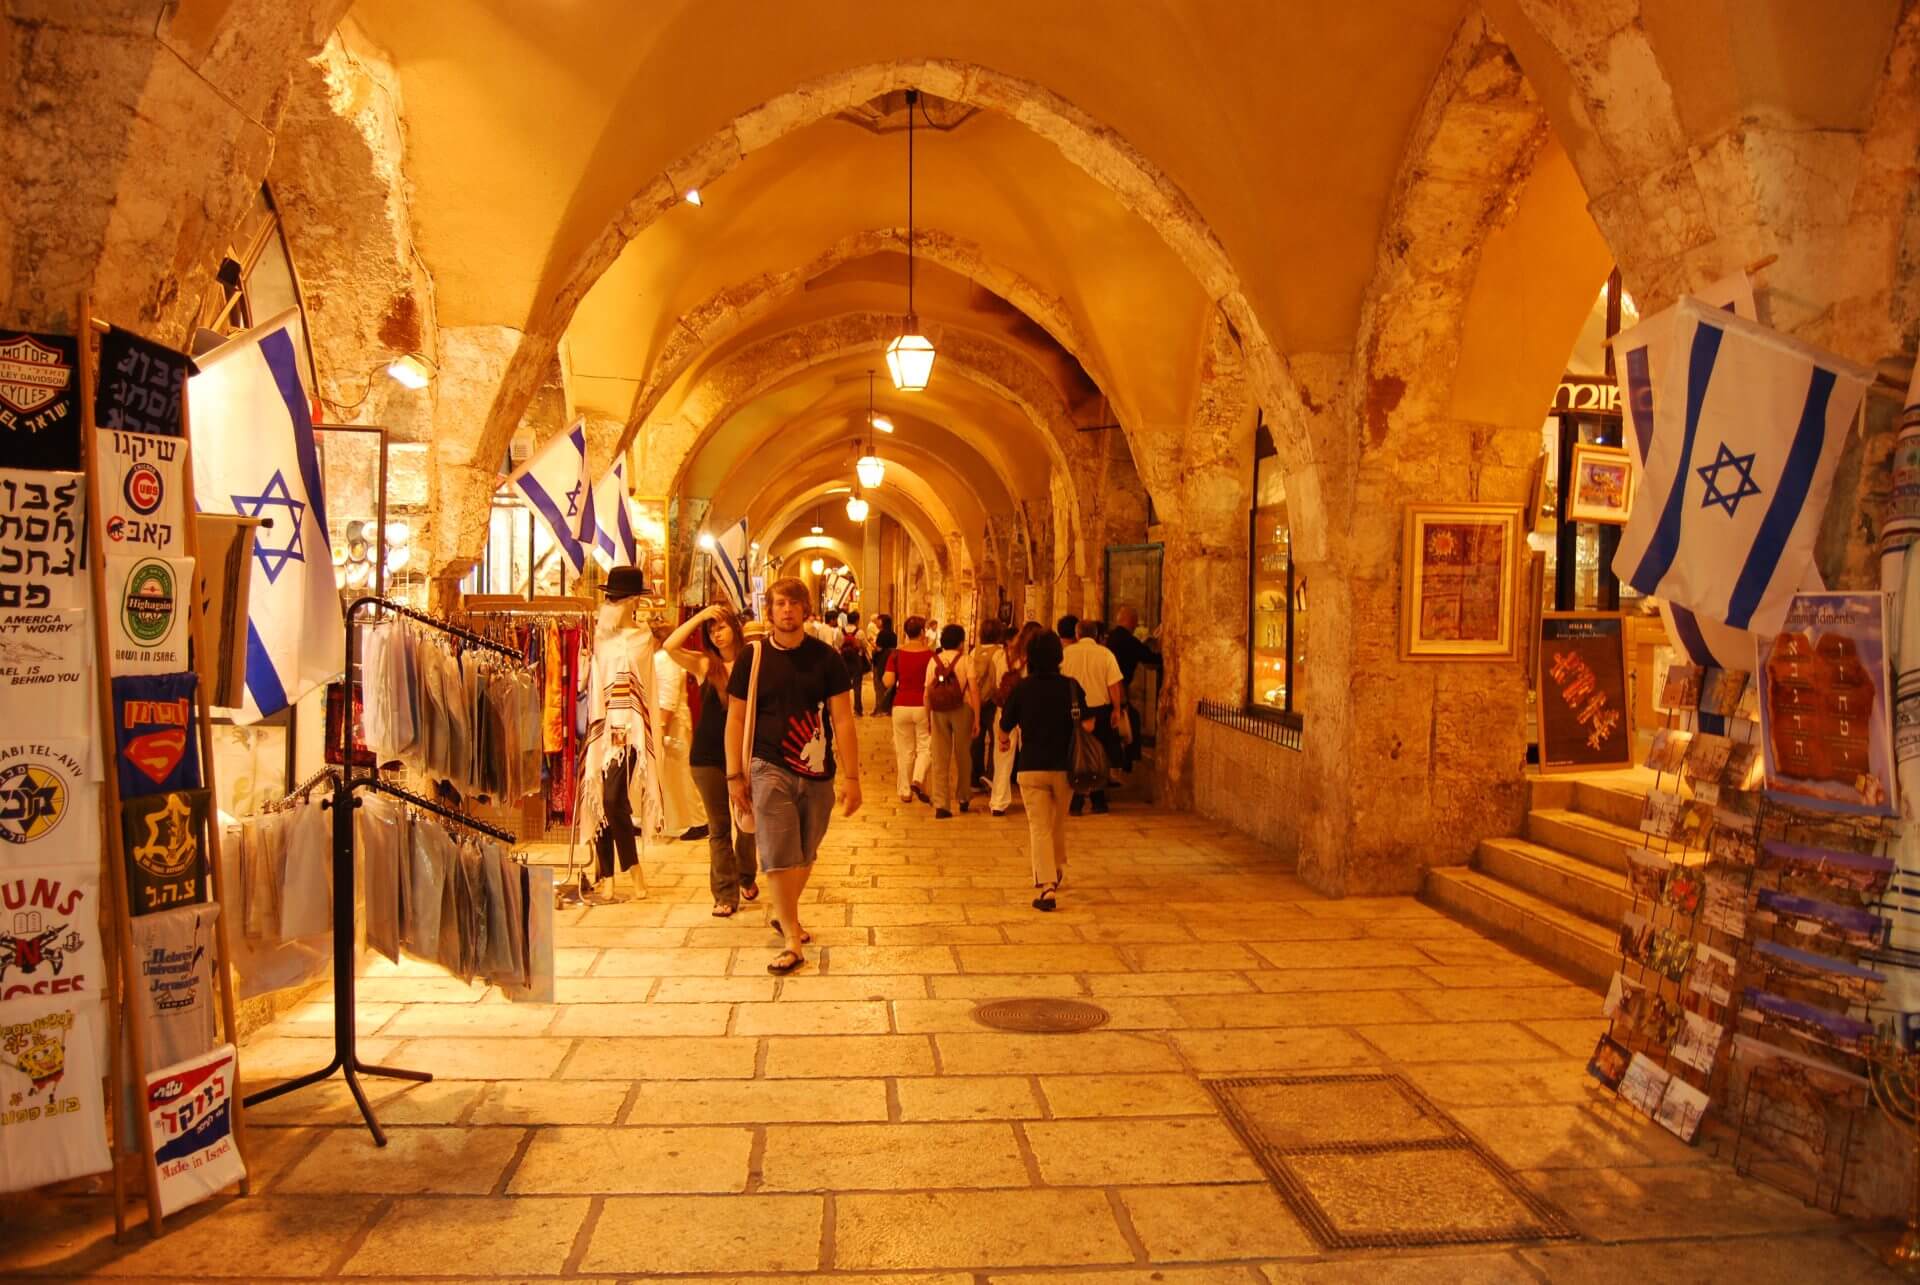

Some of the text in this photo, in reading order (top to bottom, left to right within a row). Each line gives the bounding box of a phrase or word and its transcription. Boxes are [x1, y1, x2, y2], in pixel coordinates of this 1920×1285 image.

[2, 344, 49, 362] MOTOR
[0, 371, 65, 385] LEY DAVIDSON
[1, 384, 48, 406] CYCLES
[113, 432, 176, 463] שיקגו
[126, 520, 172, 551] קאב
[0, 623, 73, 634] N'T WORRY
[4, 614, 62, 625] AMERICA
[0, 666, 41, 676] AEL IS
[10, 673, 80, 686] BEHIND YOU
[0, 745, 24, 761] ABI
[1, 878, 84, 915] UNS
[3, 975, 85, 1001] OSES
[159, 1076, 225, 1135] בזוקה
[161, 1161, 189, 1179] Made
[191, 1156, 203, 1169] in
